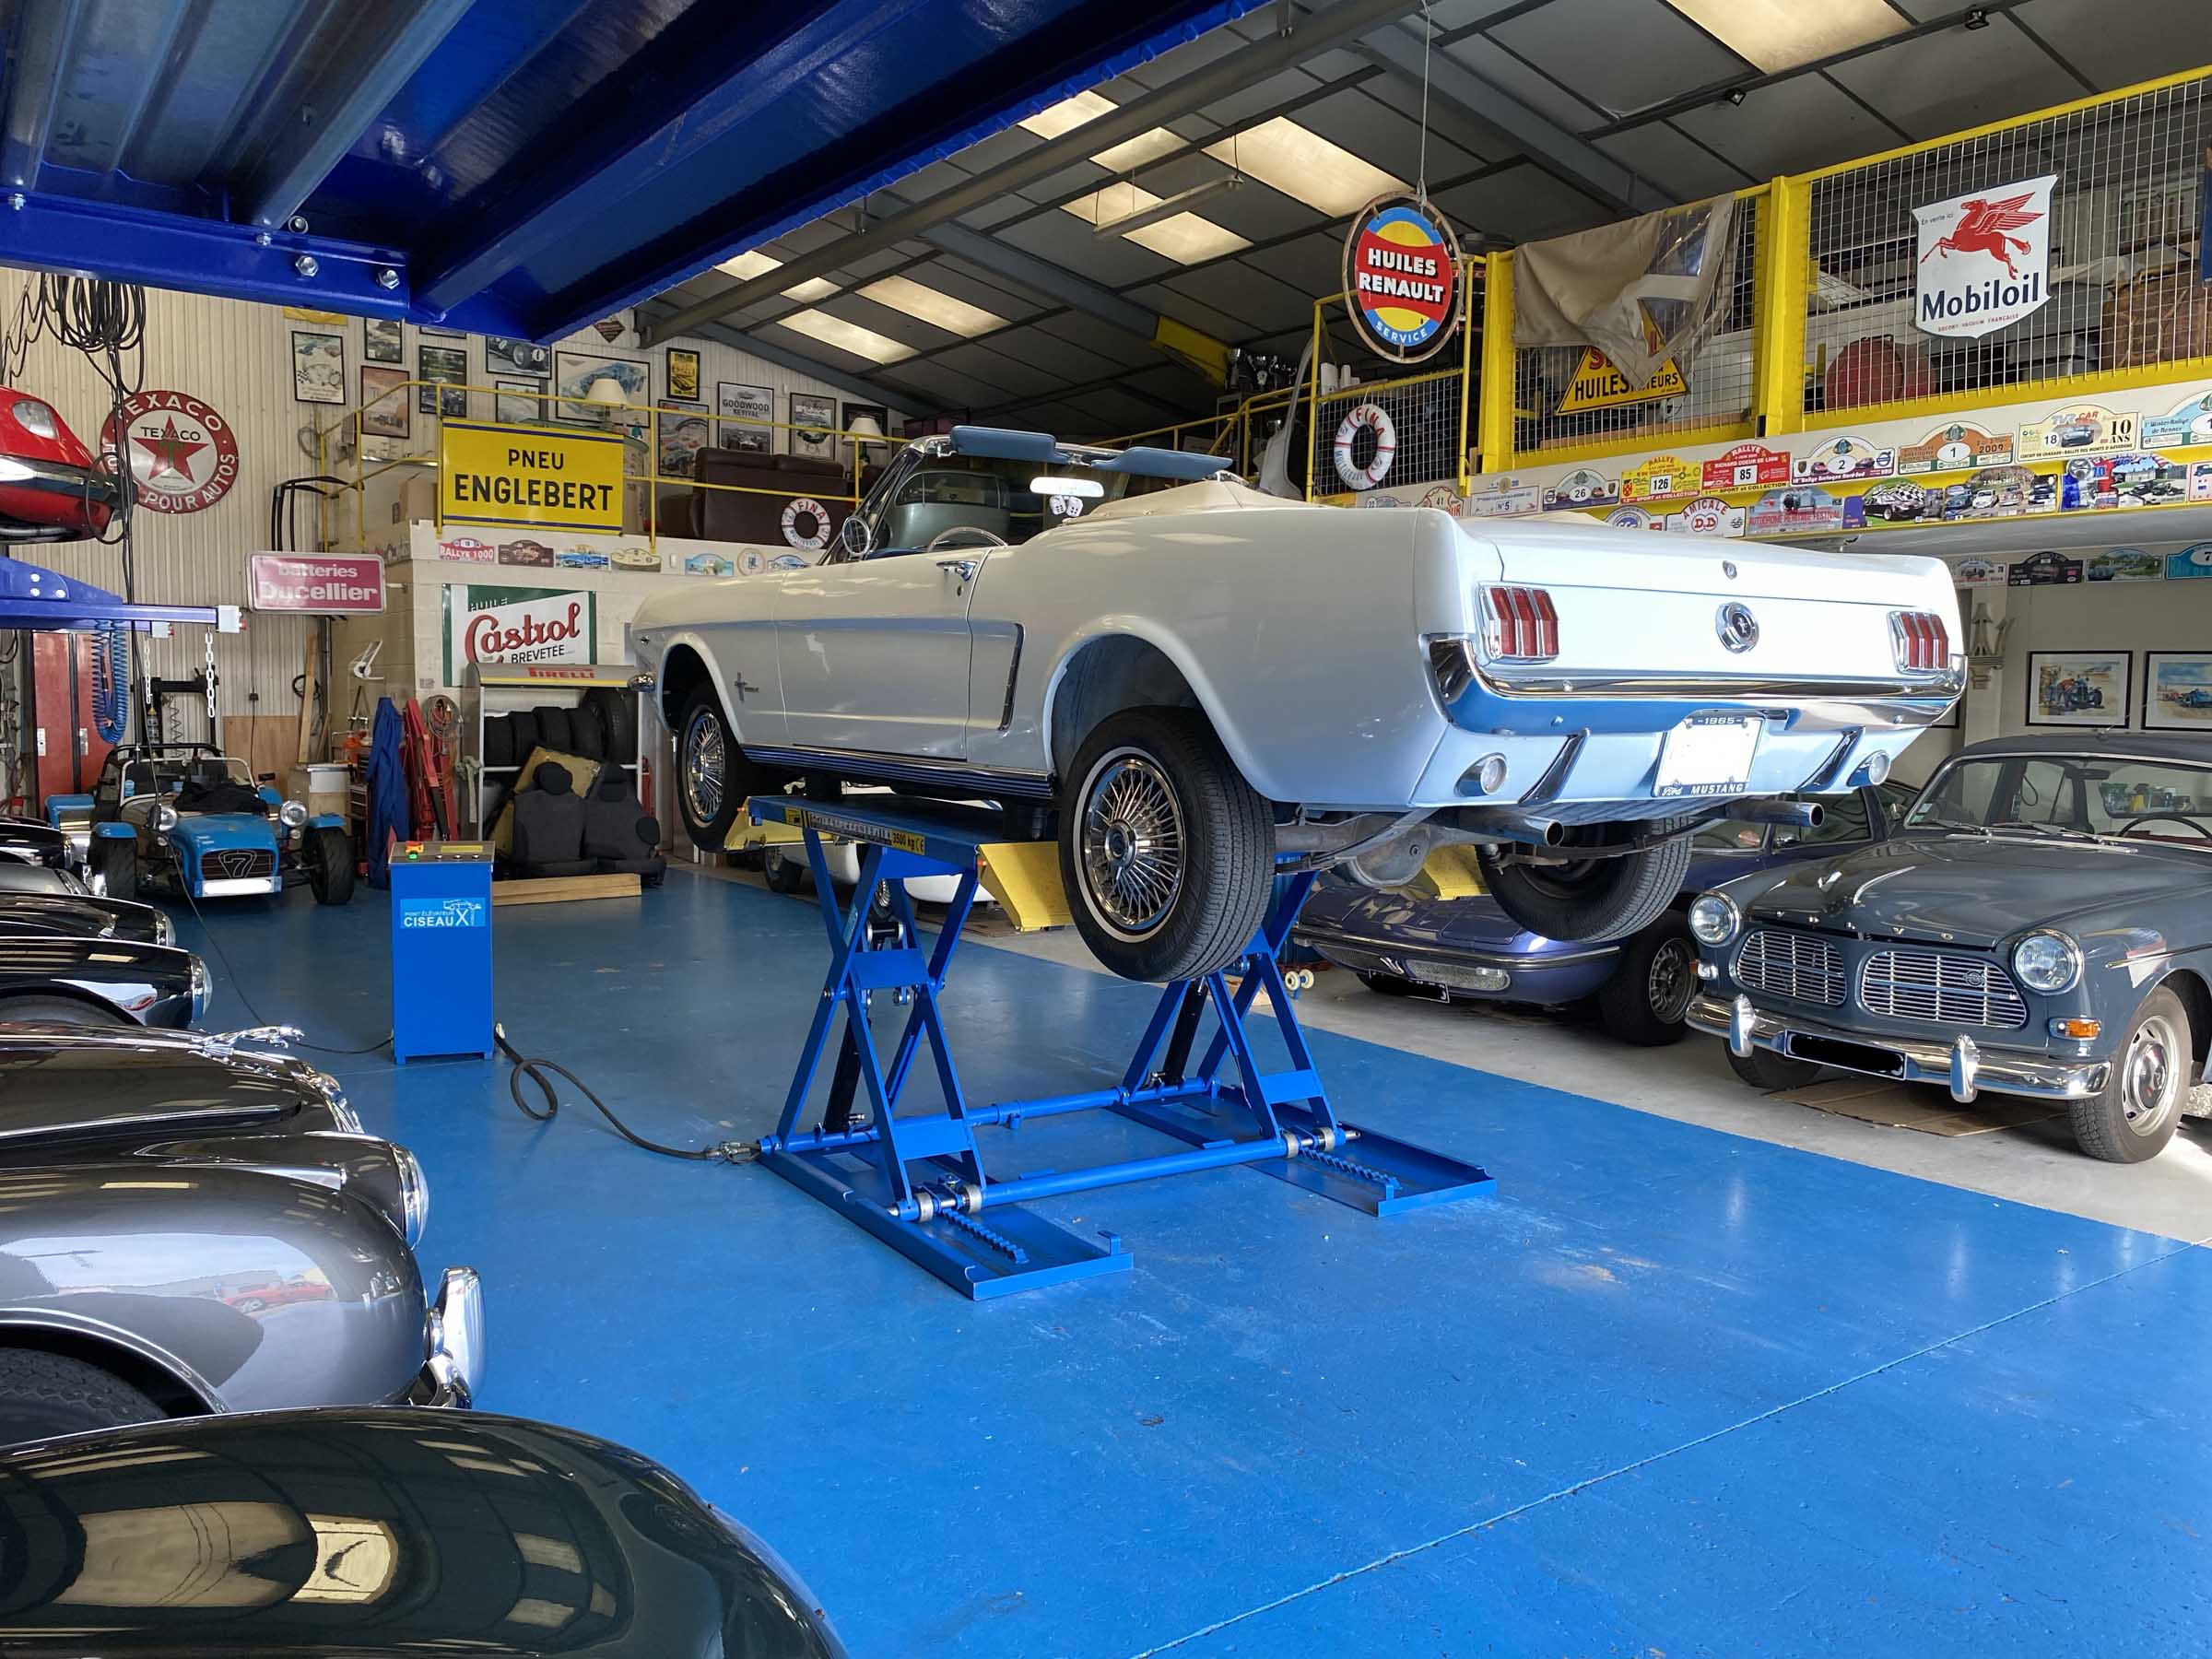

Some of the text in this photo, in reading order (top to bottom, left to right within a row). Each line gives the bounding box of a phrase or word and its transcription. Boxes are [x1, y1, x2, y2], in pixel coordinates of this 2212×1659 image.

[1921, 218, 1929, 226] En
[1929, 215, 1945, 224] vente
[1368, 248, 1437, 276] HUILES
[1359, 272, 1445, 303] RENAULT
[1923, 272, 2040, 322] Mobiloil
[1375, 321, 1428, 344] SERVICE
[1574, 374, 1630, 401] HUILES
[118, 394, 223, 431] EXACO
[723, 398, 770, 412] GOODWOOD
[1356, 407, 1385, 437] FINA
[2111, 419, 2132, 435] 10
[139, 426, 202, 441] TEXACO
[2044, 434, 2057, 445] 18
[2110, 434, 2131, 442] ANS
[1732, 445, 1761, 456] RALLYE
[1949, 447, 1956, 457] 1
[1979, 443, 2004, 453] 2009
[508, 448, 565, 470] PNEU
[1838, 459, 1845, 470] 2
[201, 453, 236, 504] AUTOS
[1739, 468, 1751, 480] 85
[1653, 478, 1669, 490] 126
[454, 473, 614, 512] ENGLEBERT
[1574, 488, 1586, 499] 26
[144, 491, 200, 511] POUR
[797, 500, 828, 521] FINA
[1683, 499, 1729, 521] AMICALE
[278, 564, 359, 578] batteries
[260, 582, 379, 601] Ducellier
[468, 597, 508, 612] HUILE
[465, 602, 581, 664] Castrol
[527, 666, 595, 679] PIRELLI
[1690, 782, 1744, 795] MUSTANG
